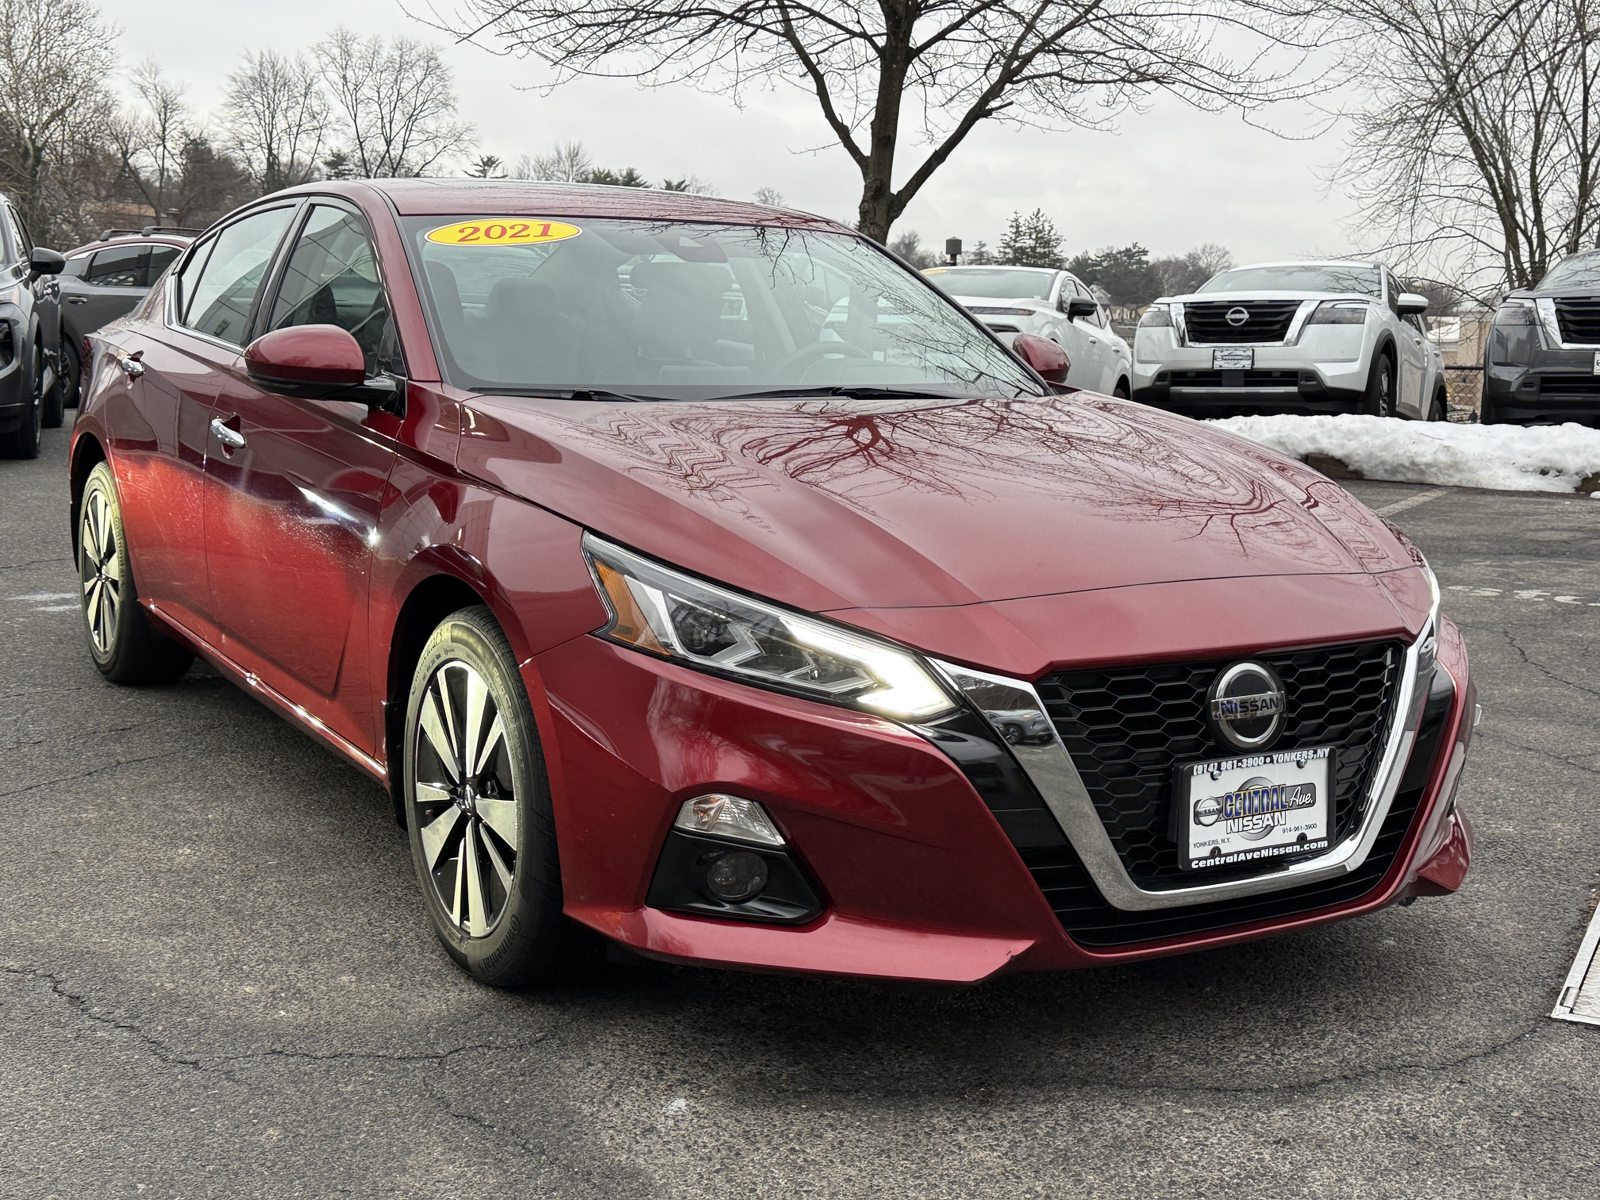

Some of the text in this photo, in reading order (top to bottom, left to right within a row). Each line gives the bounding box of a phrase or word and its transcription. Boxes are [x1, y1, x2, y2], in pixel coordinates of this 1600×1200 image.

[457, 223, 554, 243] 2021
[1220, 697, 1280, 716] NISSAN
[1223, 784, 1289, 820] CENTRAL
[1226, 810, 1287, 834] NISSAN
[1281, 823, 1318, 834] 914-961-3900
